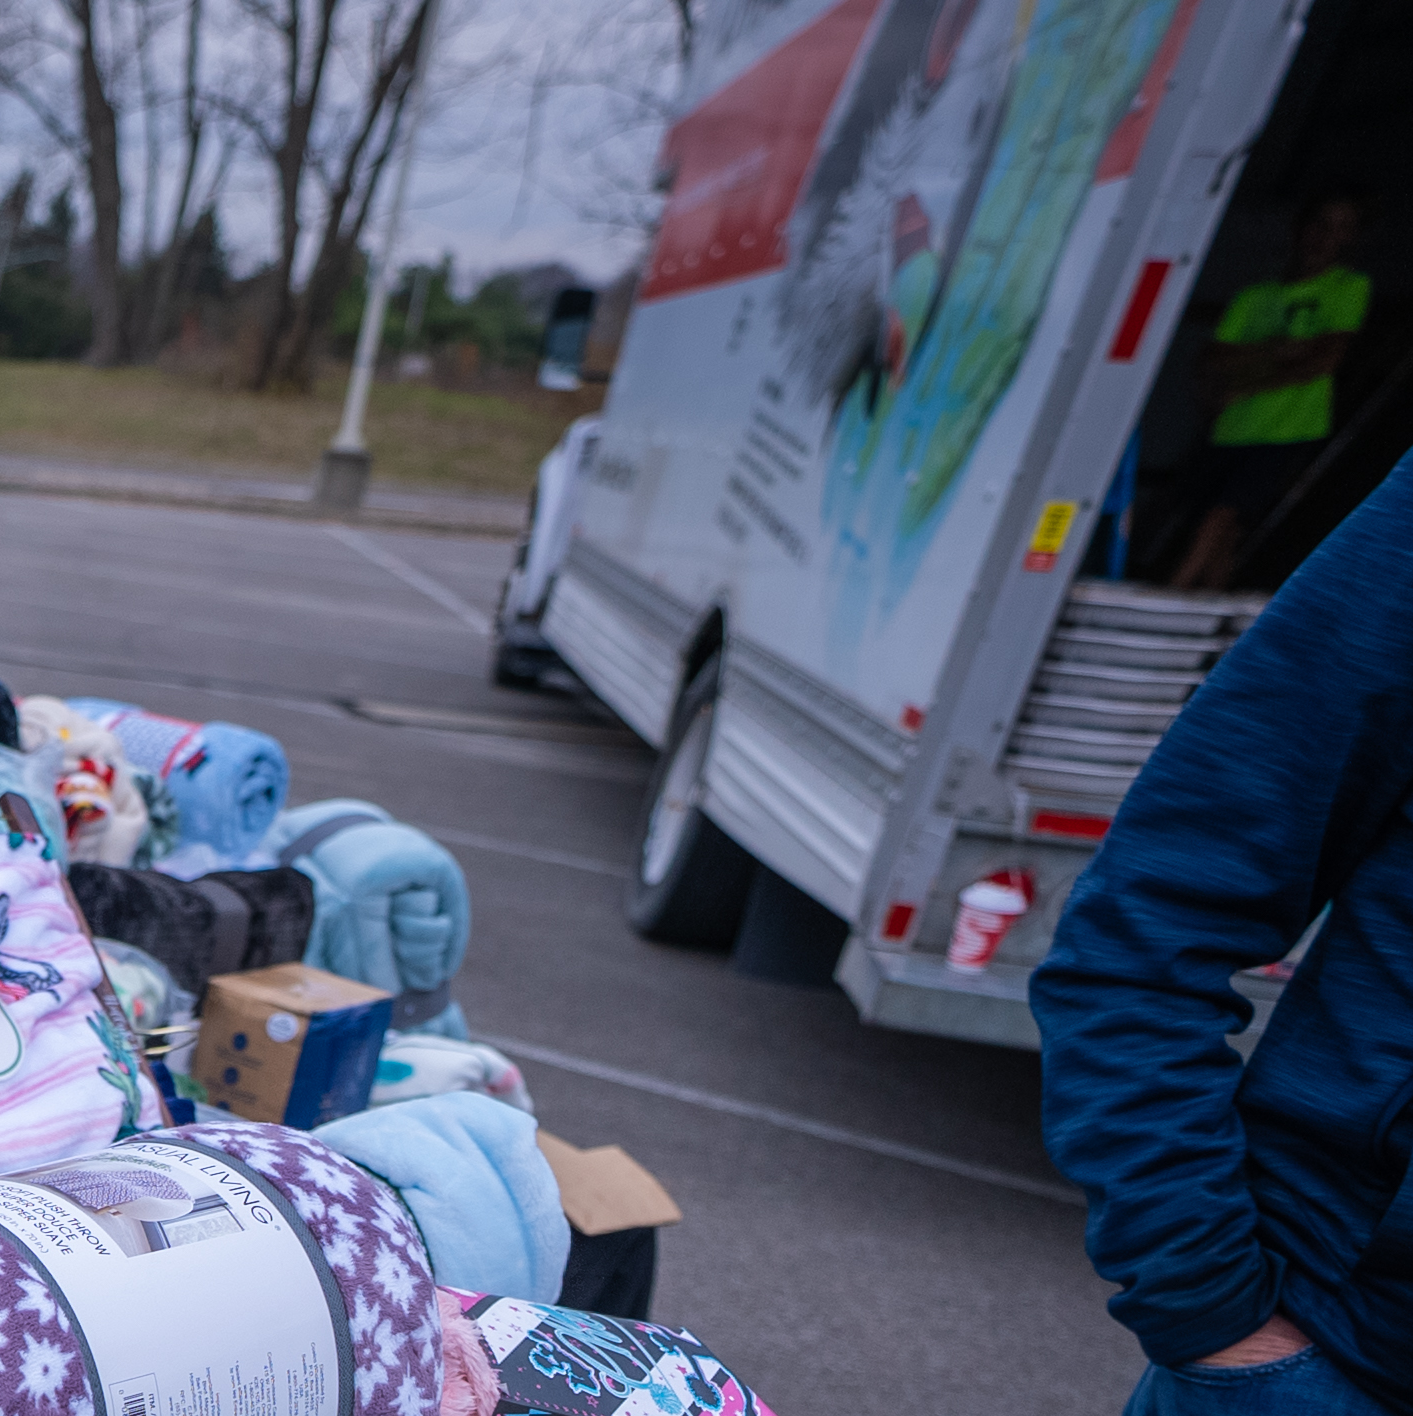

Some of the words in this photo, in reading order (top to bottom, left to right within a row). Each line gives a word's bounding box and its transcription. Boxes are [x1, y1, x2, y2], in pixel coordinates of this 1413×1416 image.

[199, 1164, 272, 1225] LIVING
[30, 1196, 70, 1218] PLUSH
[68, 1218, 110, 1255] THROW
[32, 1206, 78, 1242] DOUCE
[33, 1221, 74, 1256] SUAVE
